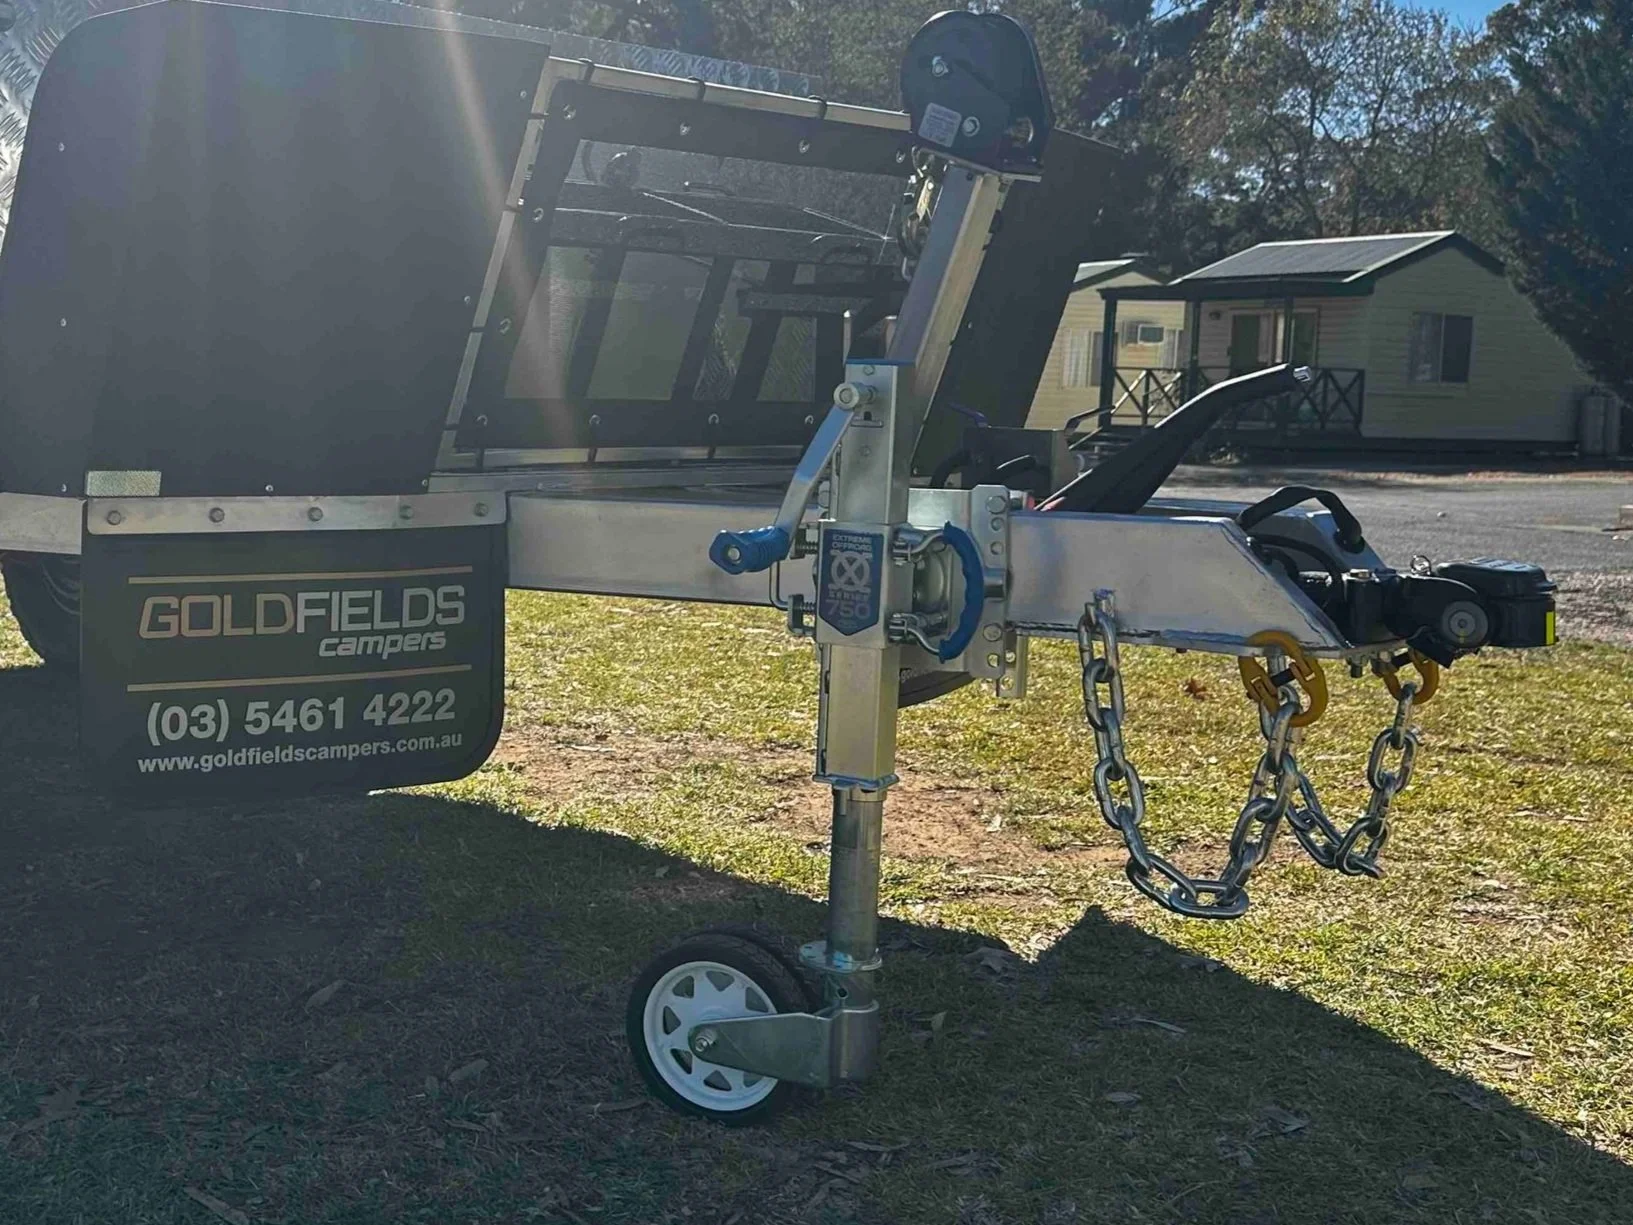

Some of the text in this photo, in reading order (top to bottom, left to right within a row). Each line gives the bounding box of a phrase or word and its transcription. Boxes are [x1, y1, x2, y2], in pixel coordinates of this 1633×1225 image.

[138, 585, 465, 639] GOLDFIELDS
[318, 630, 447, 660] campers
[147, 688, 457, 746] (03) 5461 4222
[137, 732, 463, 773] www.goldfieldscampers.com.au
